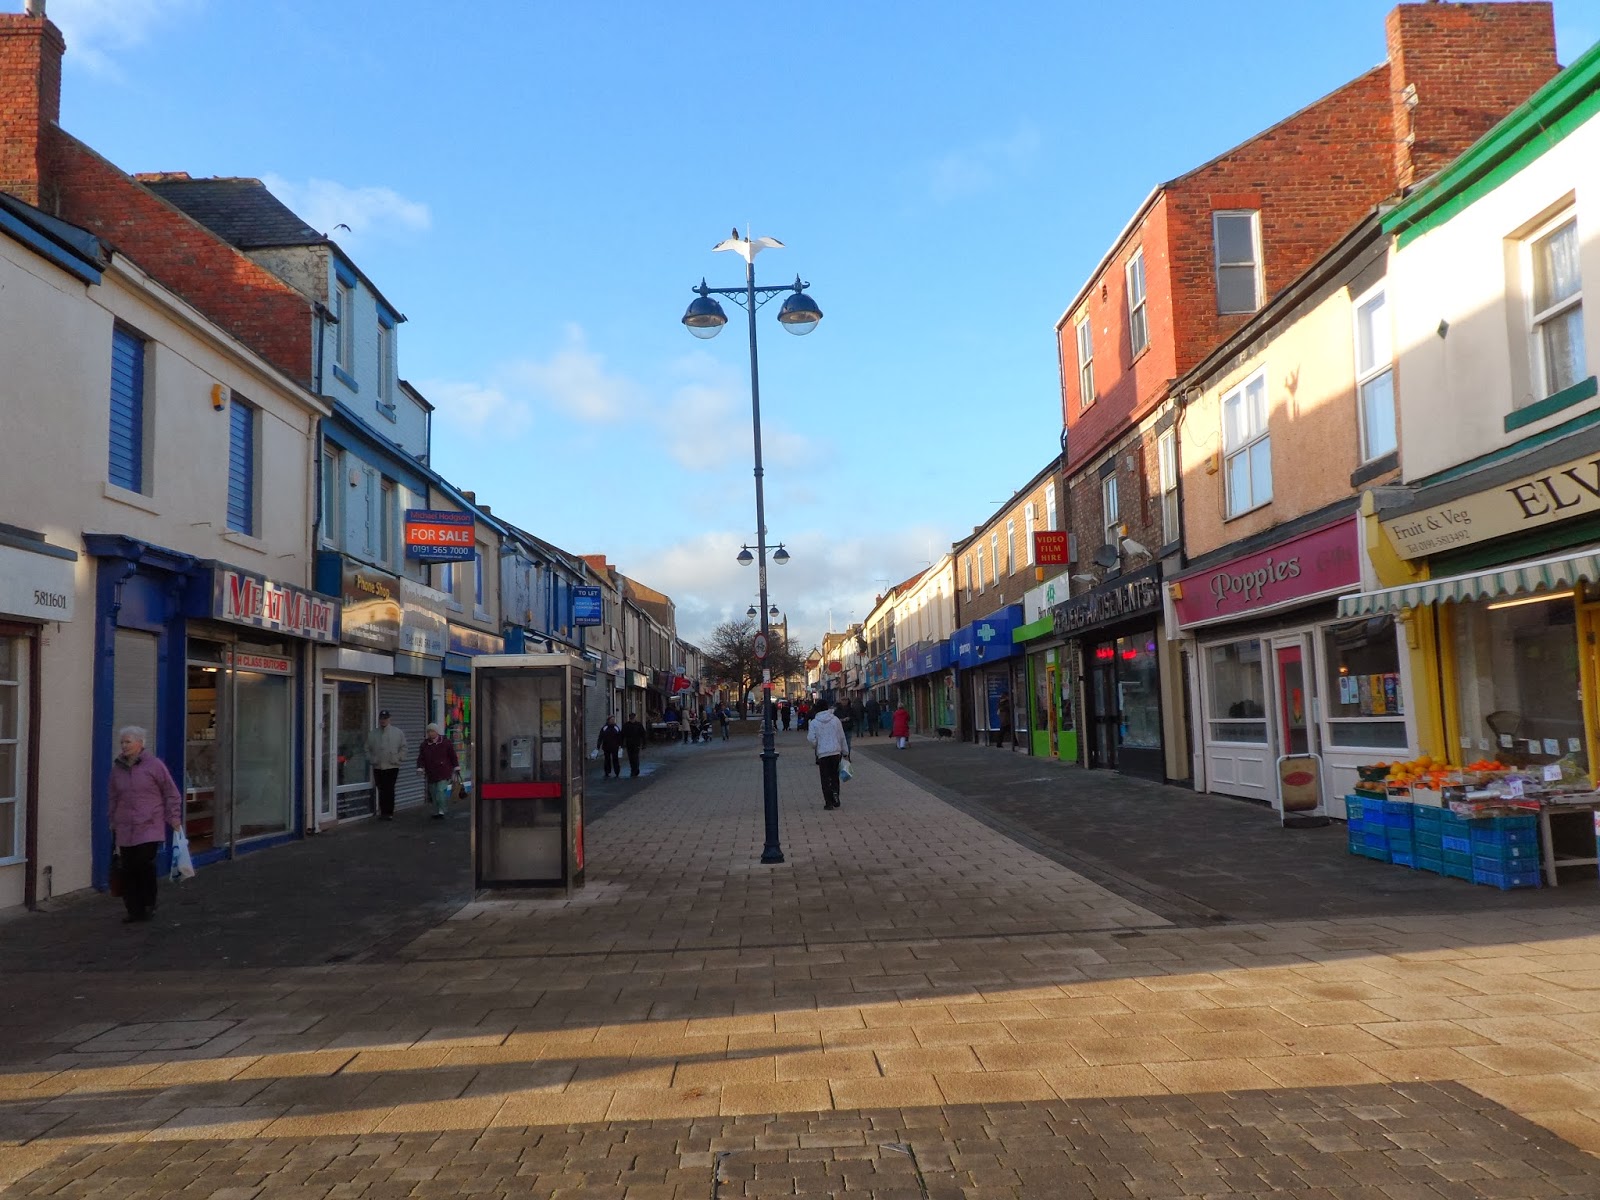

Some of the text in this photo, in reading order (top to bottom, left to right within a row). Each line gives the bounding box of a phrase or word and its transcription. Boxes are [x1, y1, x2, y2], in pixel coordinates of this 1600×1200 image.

[1392, 509, 1472, 540] Fruit & Veg
[411, 528, 469, 542] FOR SALE
[1037, 535, 1064, 543] VIDEO
[412, 545, 469, 555] 0191 565 7000
[1041, 554, 1062, 562] HIRE
[356, 575, 375, 593] Phone
[376, 582, 390, 600] Shop
[1210, 556, 1302, 610] Poppies
[34, 590, 67, 609] 5811601
[243, 656, 262, 668] CLASS
